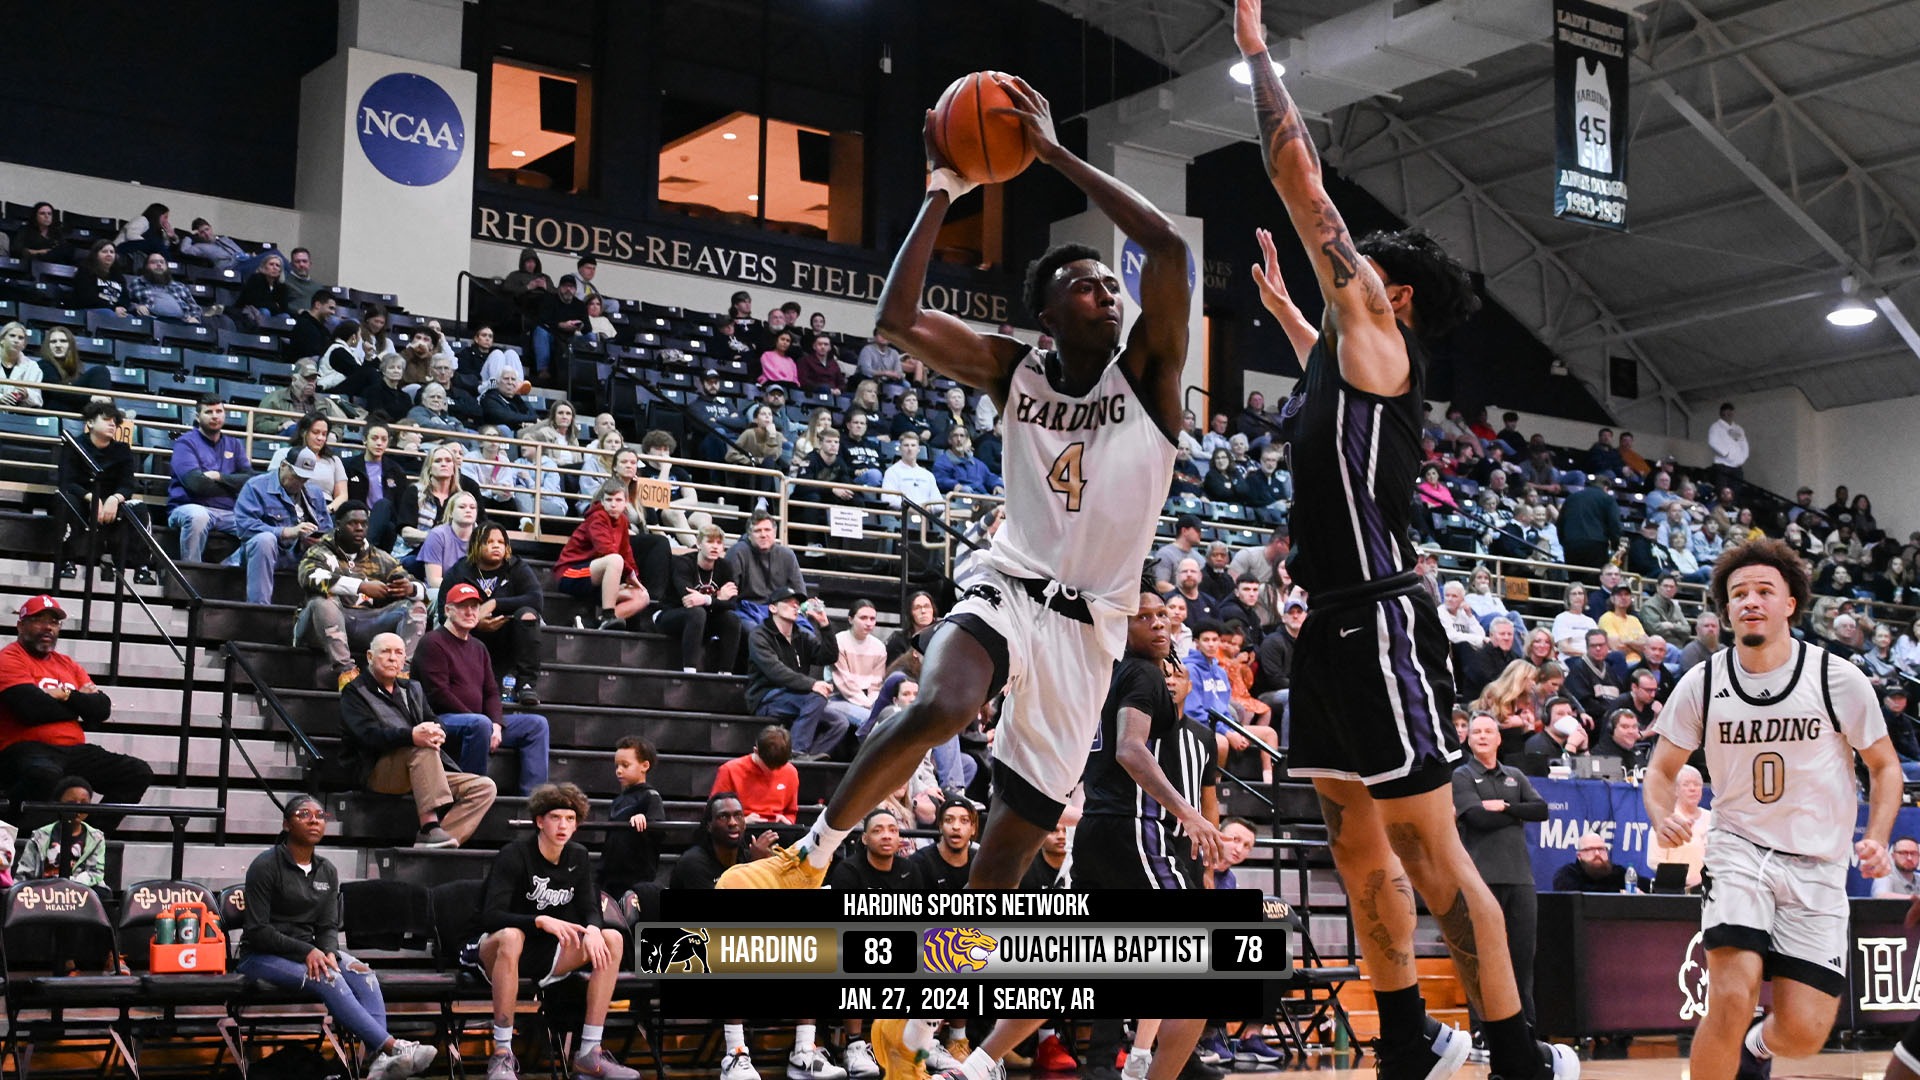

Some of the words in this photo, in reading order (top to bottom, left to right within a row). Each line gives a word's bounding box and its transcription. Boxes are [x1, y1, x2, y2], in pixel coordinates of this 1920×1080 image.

[1576, 89, 1608, 111] HARDING
[363, 106, 458, 151] NCAA
[1579, 115, 1606, 146] 45
[1565, 191, 1627, 224] 1993-1997
[478, 207, 777, 285] RHODES-REAVES
[920, 283, 1008, 322] OUSE
[1017, 393, 1125, 431] HARDING
[1046, 442, 1088, 512] 4
[1719, 718, 1821, 744] HARDING
[1752, 752, 1785, 804] 0
[1540, 818, 1616, 850] MAKE
[1622, 822, 1648, 851] IT
[42, 888, 88, 907] Unity
[158, 888, 204, 903] Unity
[181, 926, 193, 939] G
[178, 949, 196, 969] G
